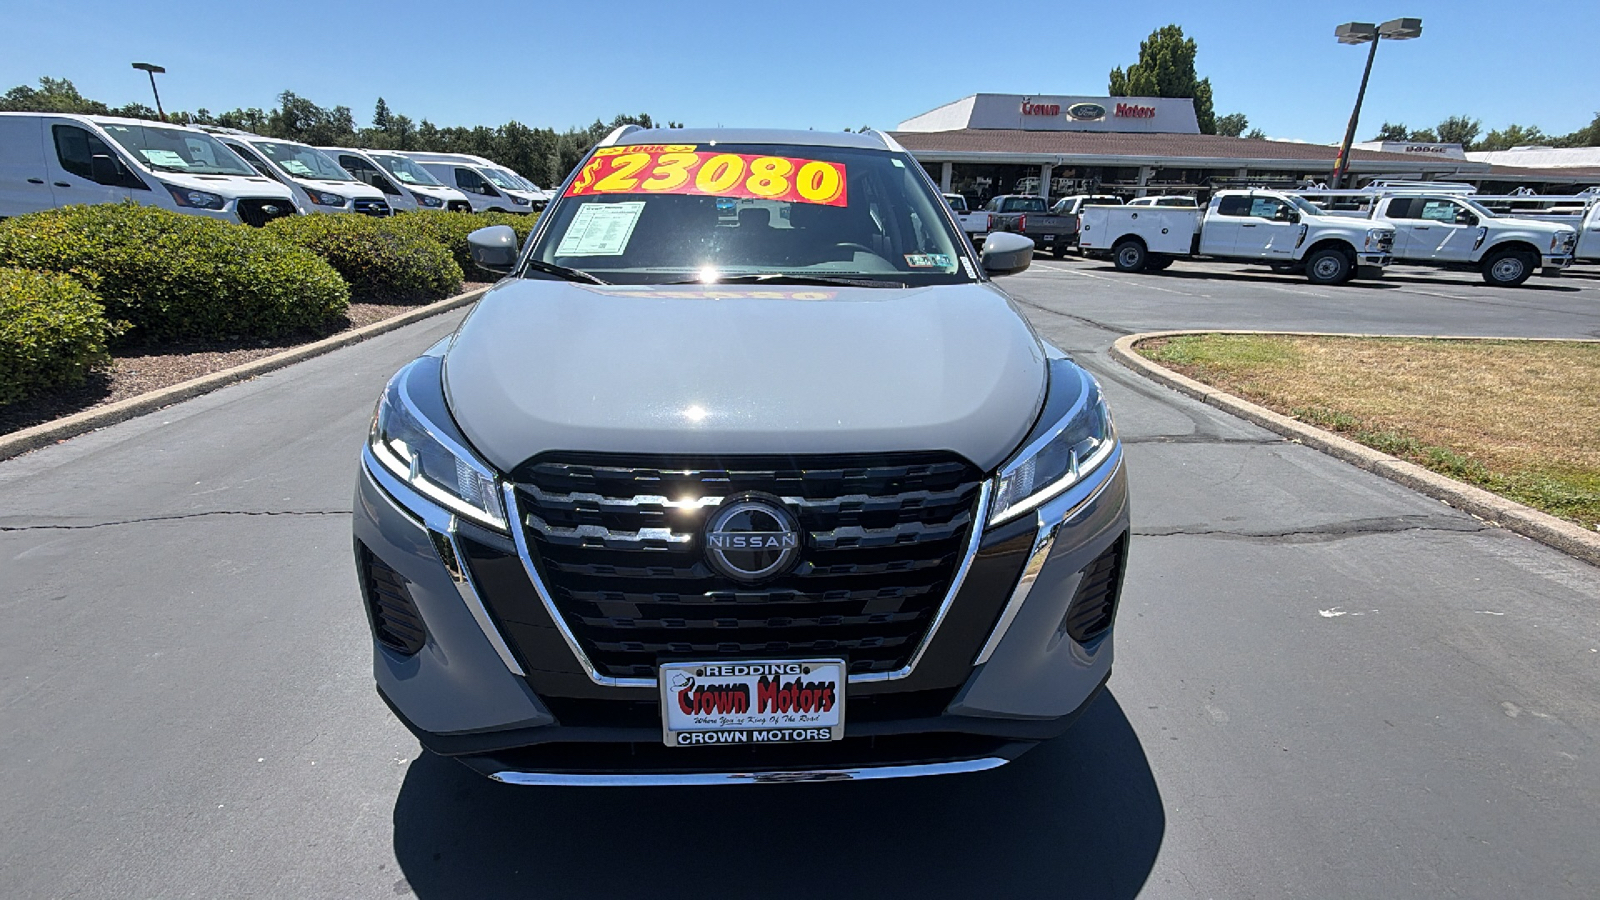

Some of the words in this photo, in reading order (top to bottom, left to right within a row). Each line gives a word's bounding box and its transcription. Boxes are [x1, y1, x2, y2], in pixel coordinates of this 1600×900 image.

[1021, 102, 1060, 116] Crown
[1115, 103, 1156, 118] Motors
[622, 145, 666, 154] LOOK
[573, 152, 844, 203] $23080
[709, 535, 795, 547] NISSAN
[706, 665, 800, 676] REDDING
[678, 683, 750, 715] Crown
[757, 675, 836, 714] Motors
[694, 716, 717, 724] Where
[747, 716, 766, 725] King
[769, 715, 779, 724] Of
[782, 714, 796, 722] The
[799, 714, 820, 722] Road
[678, 731, 748, 744] CROWN
[752, 728, 831, 741] MOTORS
